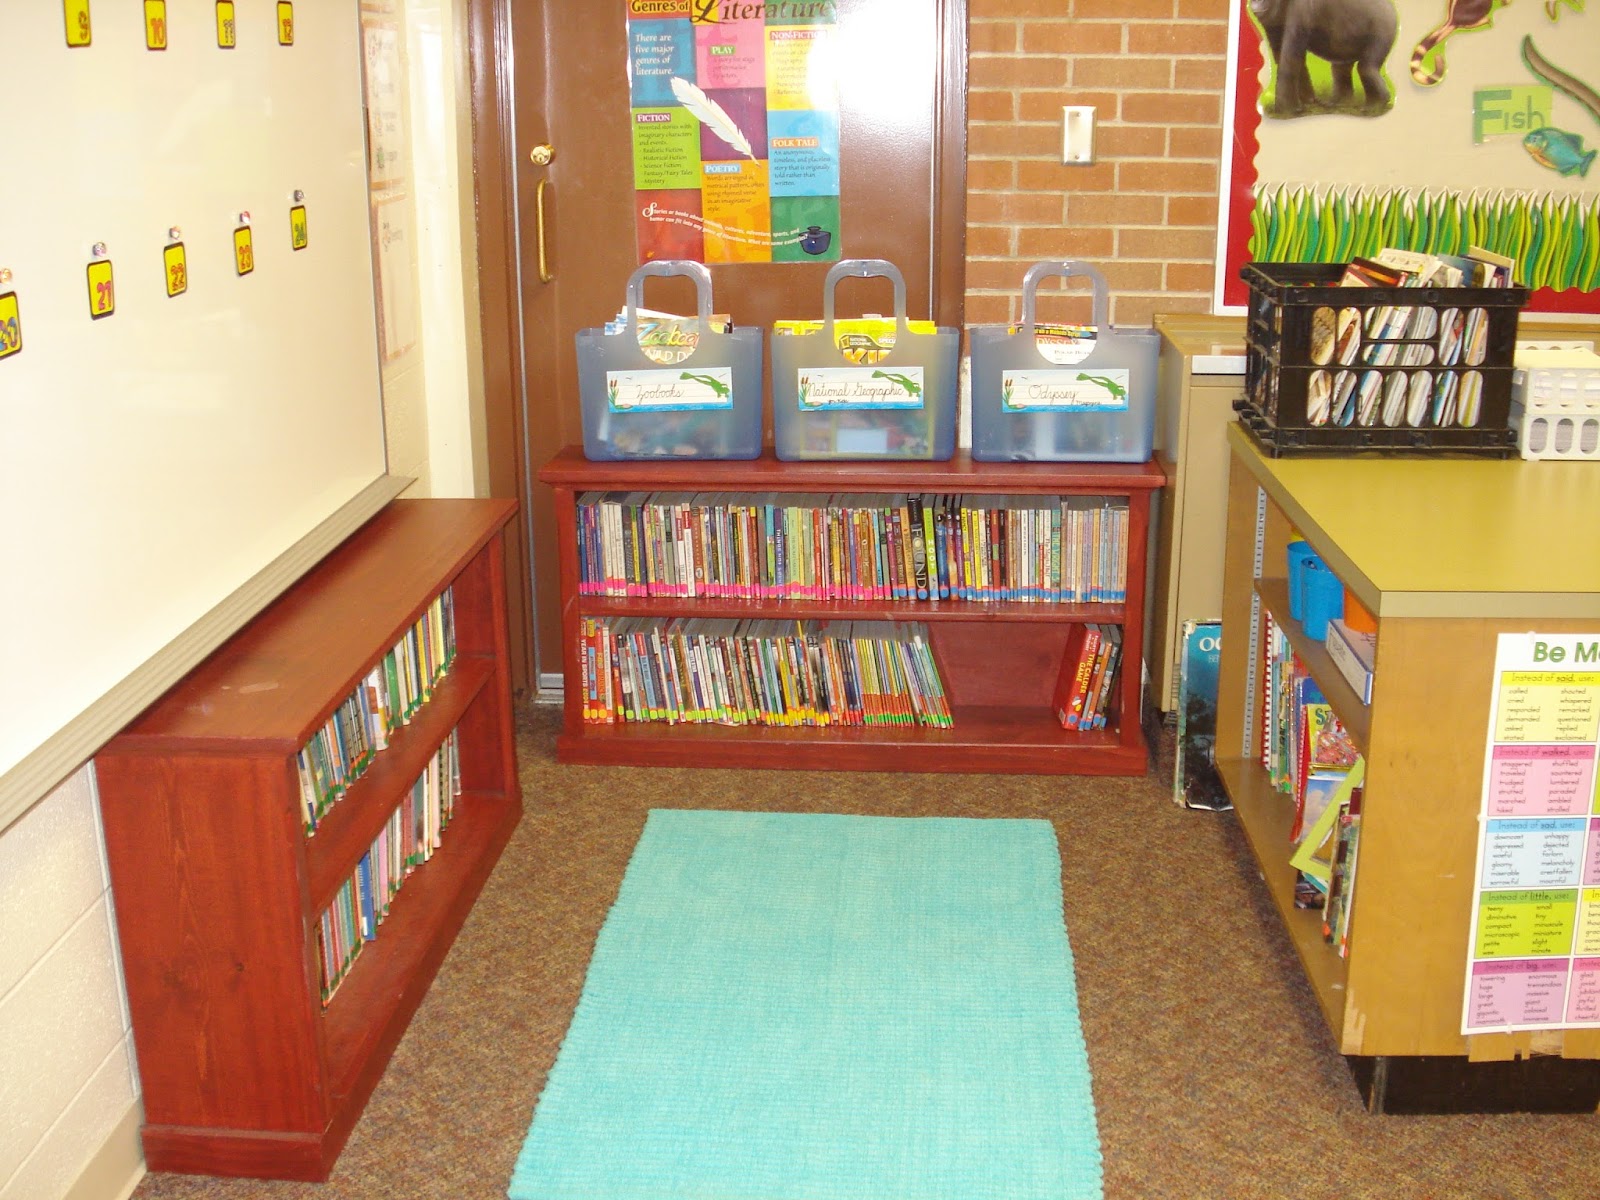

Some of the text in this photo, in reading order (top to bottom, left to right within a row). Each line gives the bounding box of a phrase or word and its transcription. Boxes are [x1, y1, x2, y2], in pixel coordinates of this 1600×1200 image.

[631, 0, 676, 12] Genres
[679, 0, 689, 11] of
[150, 18, 164, 45] 10
[635, 33, 657, 42] There
[635, 45, 675, 56] five major
[635, 55, 671, 68] genres of
[711, 46, 734, 55] PLAY
[637, 114, 670, 122] FICTION
[1473, 90, 1546, 145] Fish
[773, 138, 818, 148] FOLK TALE
[705, 165, 740, 173] POETRY
[97, 280, 112, 311] 21
[637, 322, 700, 348] Zooboo
[636, 384, 685, 406] Zoobooks
[805, 381, 904, 403] National Geographic
[1028, 384, 1080, 406] Odyssey
[911, 527, 927, 589] FOUND
[927, 539, 935, 569] HOOT
[1532, 641, 1566, 663] Be
[1075, 662, 1086, 682] GAME
[1079, 653, 1095, 694] THE CALDER
